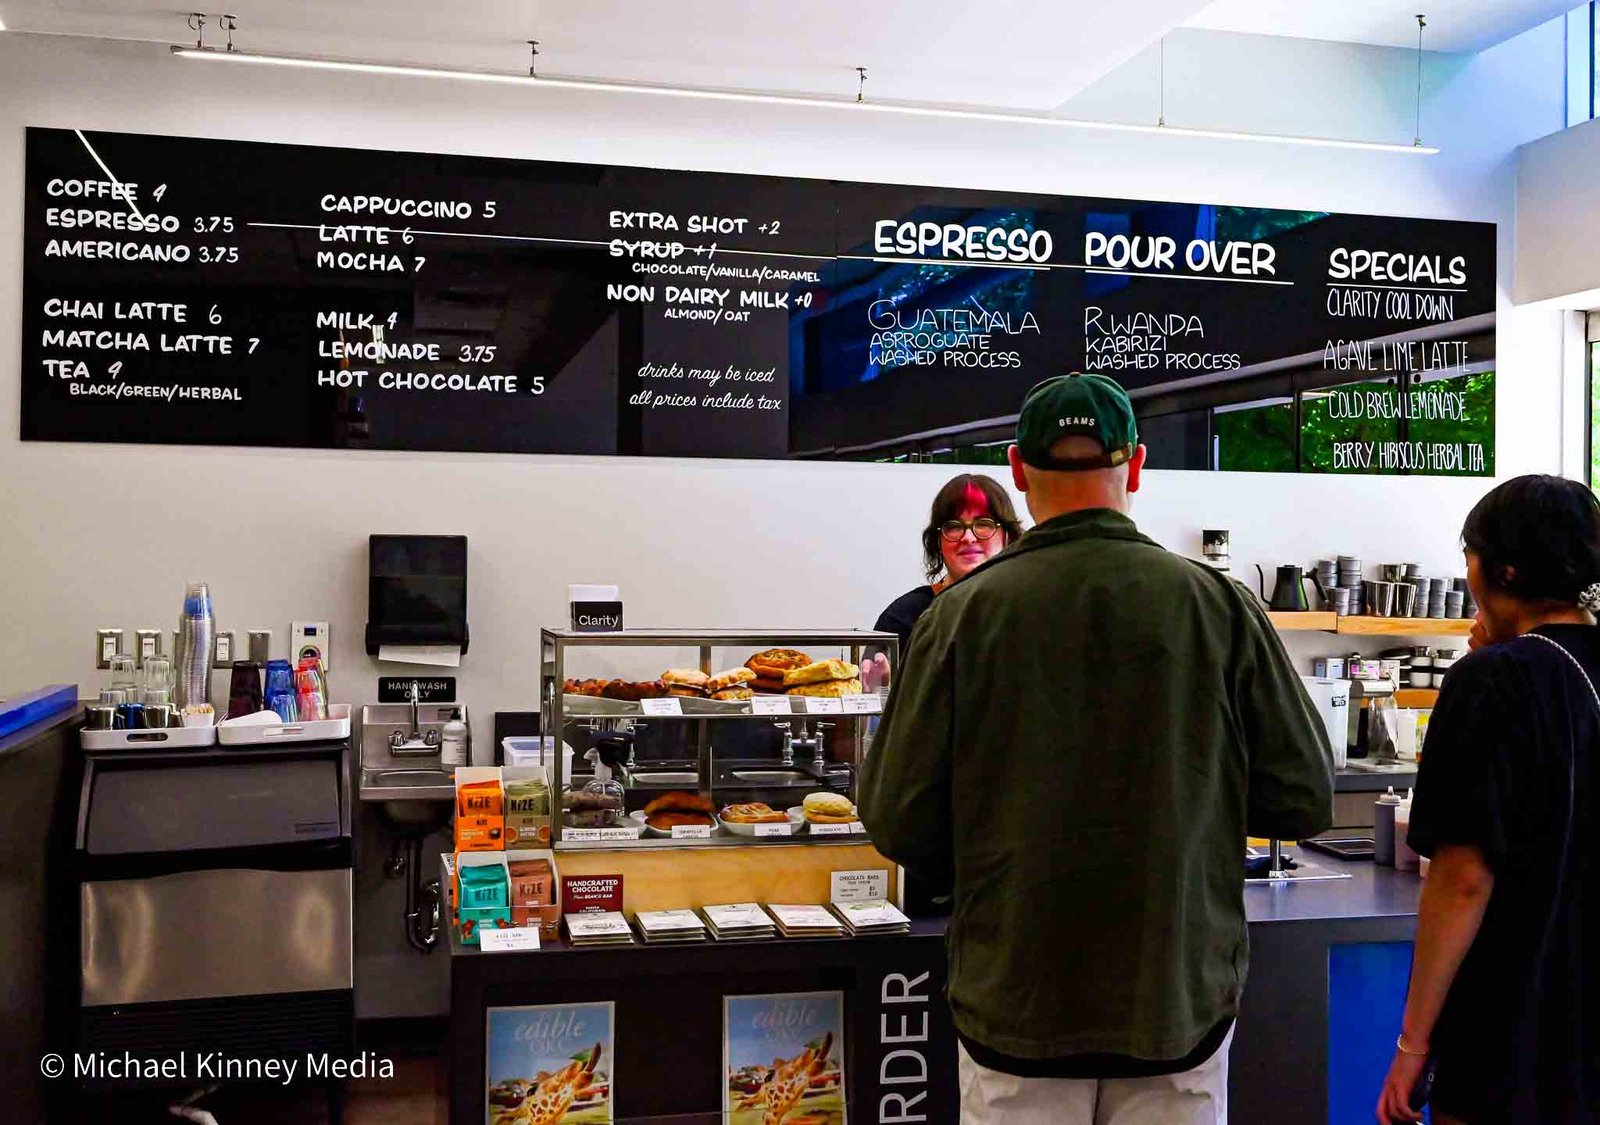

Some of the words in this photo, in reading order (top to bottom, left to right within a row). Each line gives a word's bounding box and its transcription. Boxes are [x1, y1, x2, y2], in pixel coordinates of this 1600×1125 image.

[47, 179, 137, 200] COFFEE
[320, 194, 472, 219] CAPPUCCINO
[482, 201, 497, 219] 5
[46, 208, 180, 233] ESPRESSO
[193, 217, 234, 234] 3.75
[609, 210, 679, 231] EXTRA
[687, 215, 749, 234] SHOT
[757, 220, 781, 235] +2
[318, 225, 390, 245] LATTE
[402, 227, 414, 245] 6
[874, 219, 1053, 263] ESPRESSO
[44, 240, 190, 263] AMERICANO
[199, 247, 239, 263] 3.75
[609, 239, 685, 259] SYRUP
[693, 242, 717, 260] +1
[1084, 232, 1177, 270] POUR
[1185, 239, 1276, 276] OVER
[317, 252, 405, 272] MOCHA
[414, 257, 426, 272] 7
[632, 262, 820, 283] CHOCOLATE/VANILLA/CARAMEL
[1328, 247, 1467, 285] SPECIALS
[606, 284, 654, 302] NON
[665, 286, 730, 305] DAIRY
[739, 290, 789, 309] MILK
[794, 292, 812, 308] +0
[1327, 288, 1381, 319] CLARITY
[1385, 291, 1412, 320] COOL
[1415, 294, 1453, 321] DOWN
[43, 298, 103, 320] CHAI
[114, 302, 187, 323] LATTE
[209, 304, 222, 325] 6
[316, 311, 374, 330] MILK
[387, 312, 398, 330] 4
[724, 311, 750, 323] OAT
[868, 299, 1041, 335] GUATEMALA
[1085, 306, 1204, 338] RWANDA
[42, 330, 150, 352] MATCHA
[160, 334, 232, 355] LATTE
[247, 338, 260, 355] 7
[318, 340, 440, 361] LEMONADE
[458, 345, 497, 363] 3.75
[1085, 335, 1167, 353] KABIRIZI
[869, 350, 936, 367] WASHED
[944, 351, 1021, 368] PROCESS
[1085, 353, 1160, 370] WASHED
[1165, 352, 1241, 371] PROCESS
[1323, 340, 1377, 370] AGAVE
[1383, 341, 1415, 371] LIME
[1422, 341, 1470, 372] LATTE
[42, 360, 90, 379] TEA
[637, 362, 684, 378] drinks
[688, 368, 721, 387] may
[725, 365, 742, 381] be
[745, 367, 776, 382] iced
[69, 382, 242, 402] BLACK/GREEN/HERBAL
[317, 370, 368, 388] HOT
[378, 371, 517, 393] CHOCOLATE
[530, 376, 545, 395] 5
[629, 390, 652, 405] all
[652, 393, 697, 409] prices
[702, 392, 755, 409] include
[757, 396, 782, 410] tax
[1328, 390, 1363, 419] COLD
[1367, 391, 1401, 419] BREW
[1405, 391, 1469, 422] LEMONADE
[1059, 416, 1095, 427] BEAMS
[1334, 441, 1375, 470] BERRY
[1379, 441, 1423, 470] HIBISCUS
[1427, 443, 1466, 470] HERBAL
[1467, 443, 1485, 471] TEA
[579, 615, 619, 628] Clarity
[404, 690, 430, 698] OLY
[419, 682, 446, 690] WASH
[513, 1009, 585, 1041] edible
[879, 970, 930, 1124] RDER
